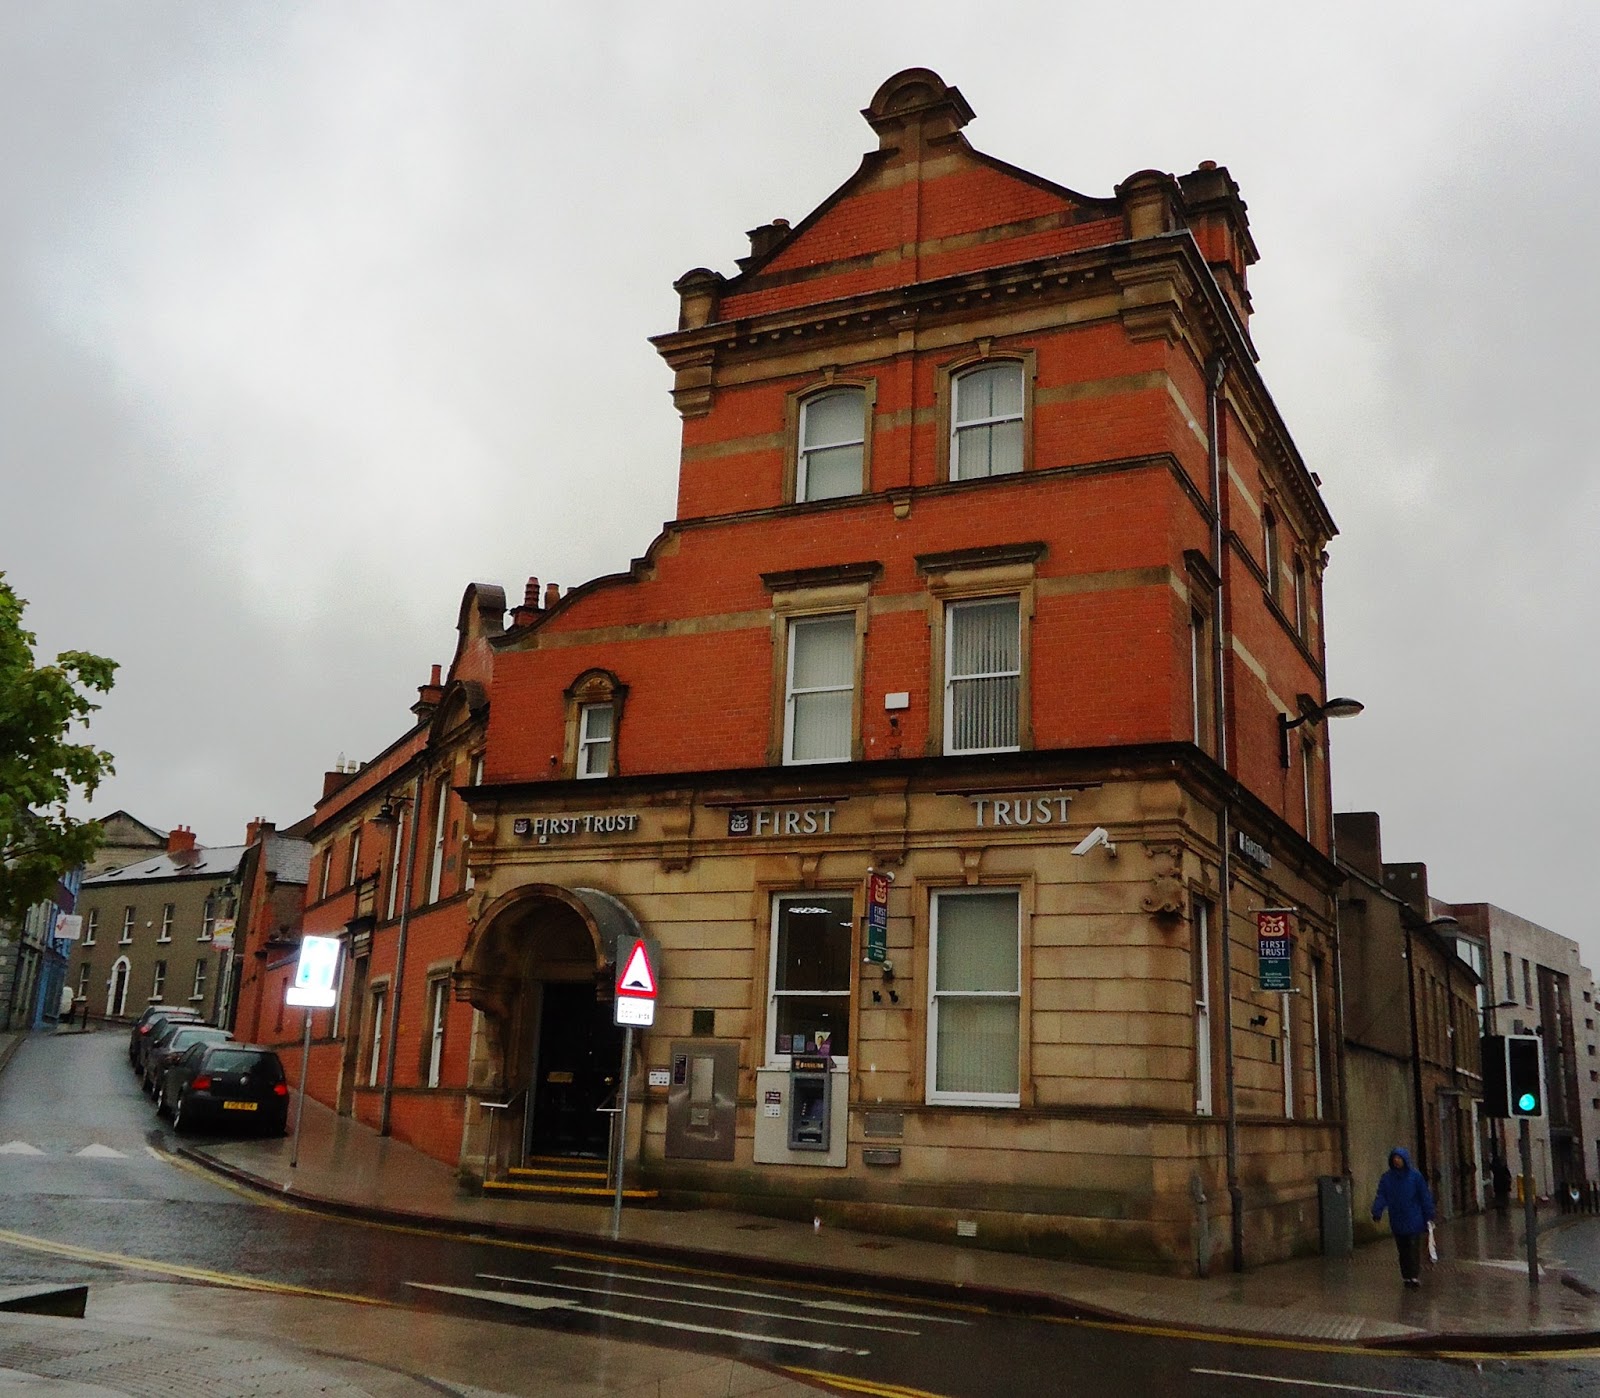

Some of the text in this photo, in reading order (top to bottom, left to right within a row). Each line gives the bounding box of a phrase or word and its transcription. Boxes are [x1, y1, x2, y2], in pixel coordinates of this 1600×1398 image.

[755, 796, 1073, 835] FIRST TRUST
[533, 814, 637, 835] FIRST TRUST
[1260, 940, 1286, 948] FIRST
[1260, 948, 1286, 956] TRUST
